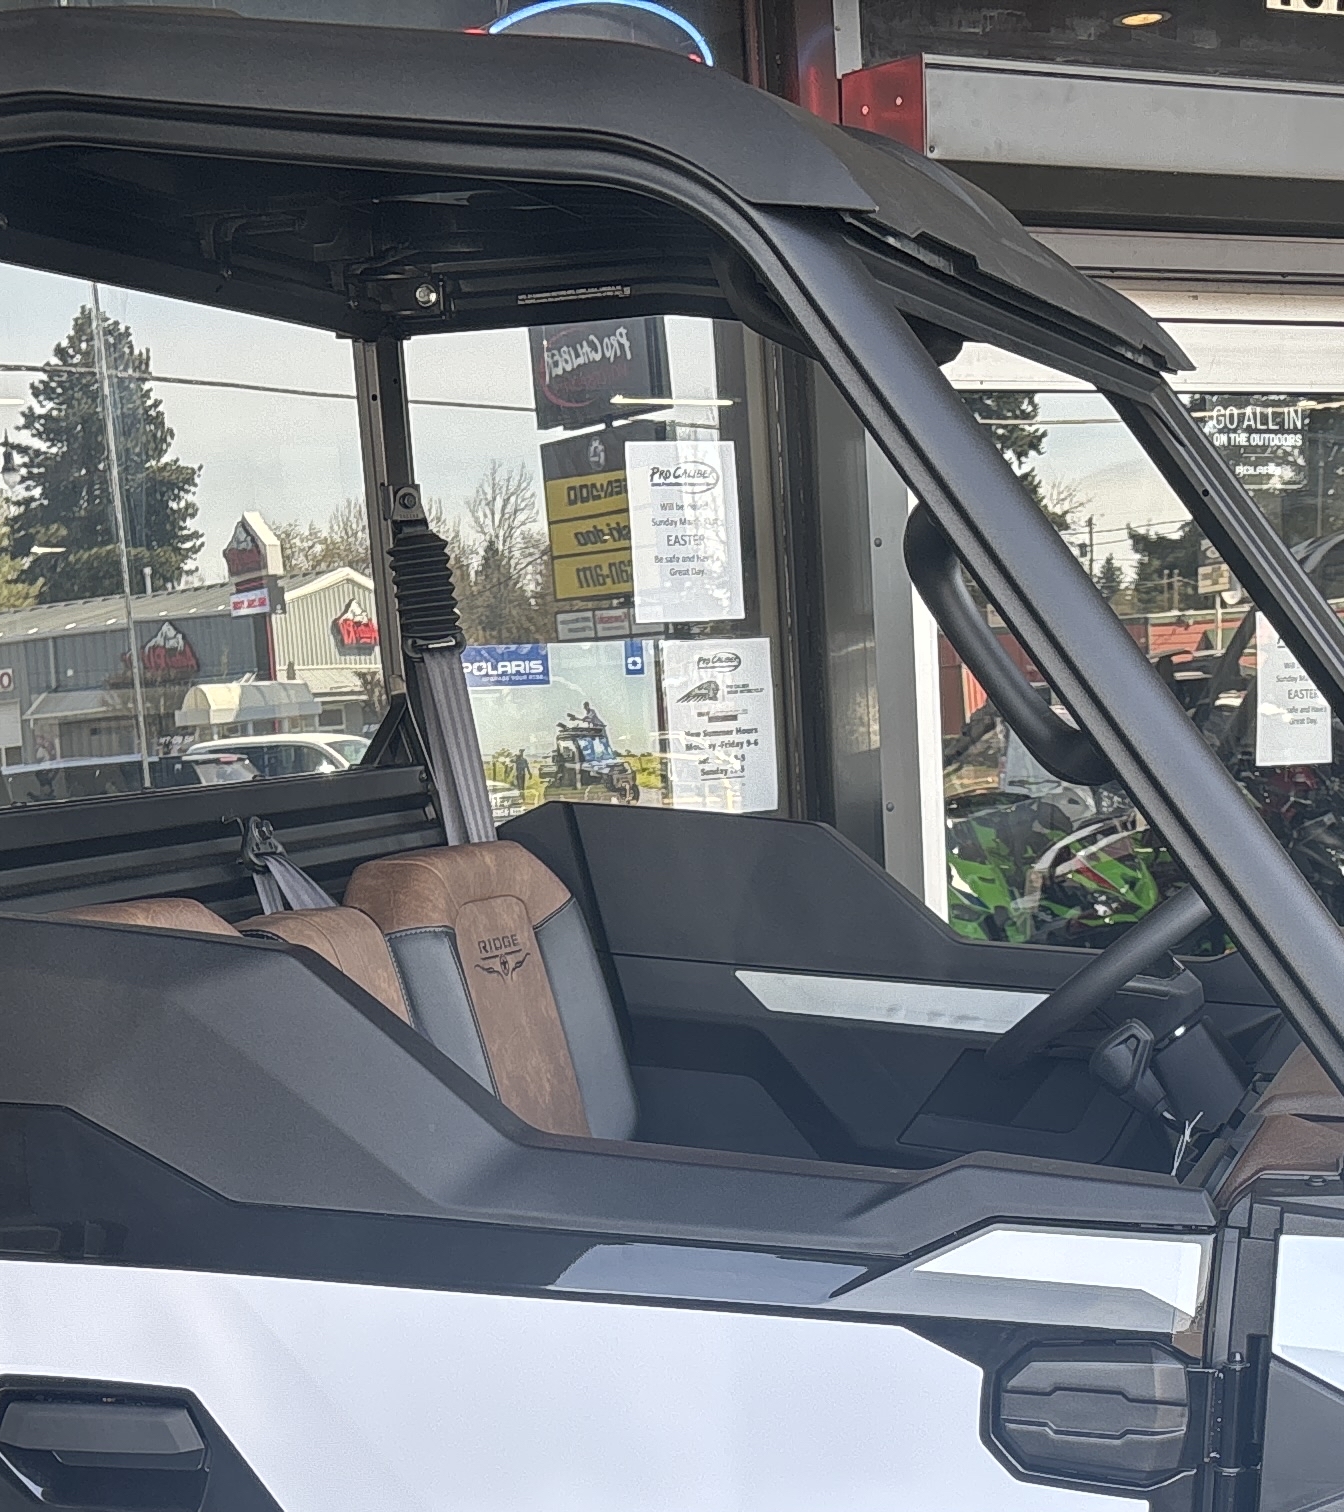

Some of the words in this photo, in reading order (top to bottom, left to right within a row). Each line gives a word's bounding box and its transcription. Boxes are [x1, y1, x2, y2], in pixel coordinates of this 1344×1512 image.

[1214, 406, 1238, 429] GO
[1242, 405, 1279, 429] ALL
[1284, 407, 1302, 429] IN
[1213, 433, 1228, 446] ON
[1229, 433, 1250, 446] THE
[1250, 433, 1303, 446] OUTDOORS
[650, 467, 671, 482] PRO
[463, 660, 544, 676] POLARIS
[478, 933, 521, 954] RIDGE
